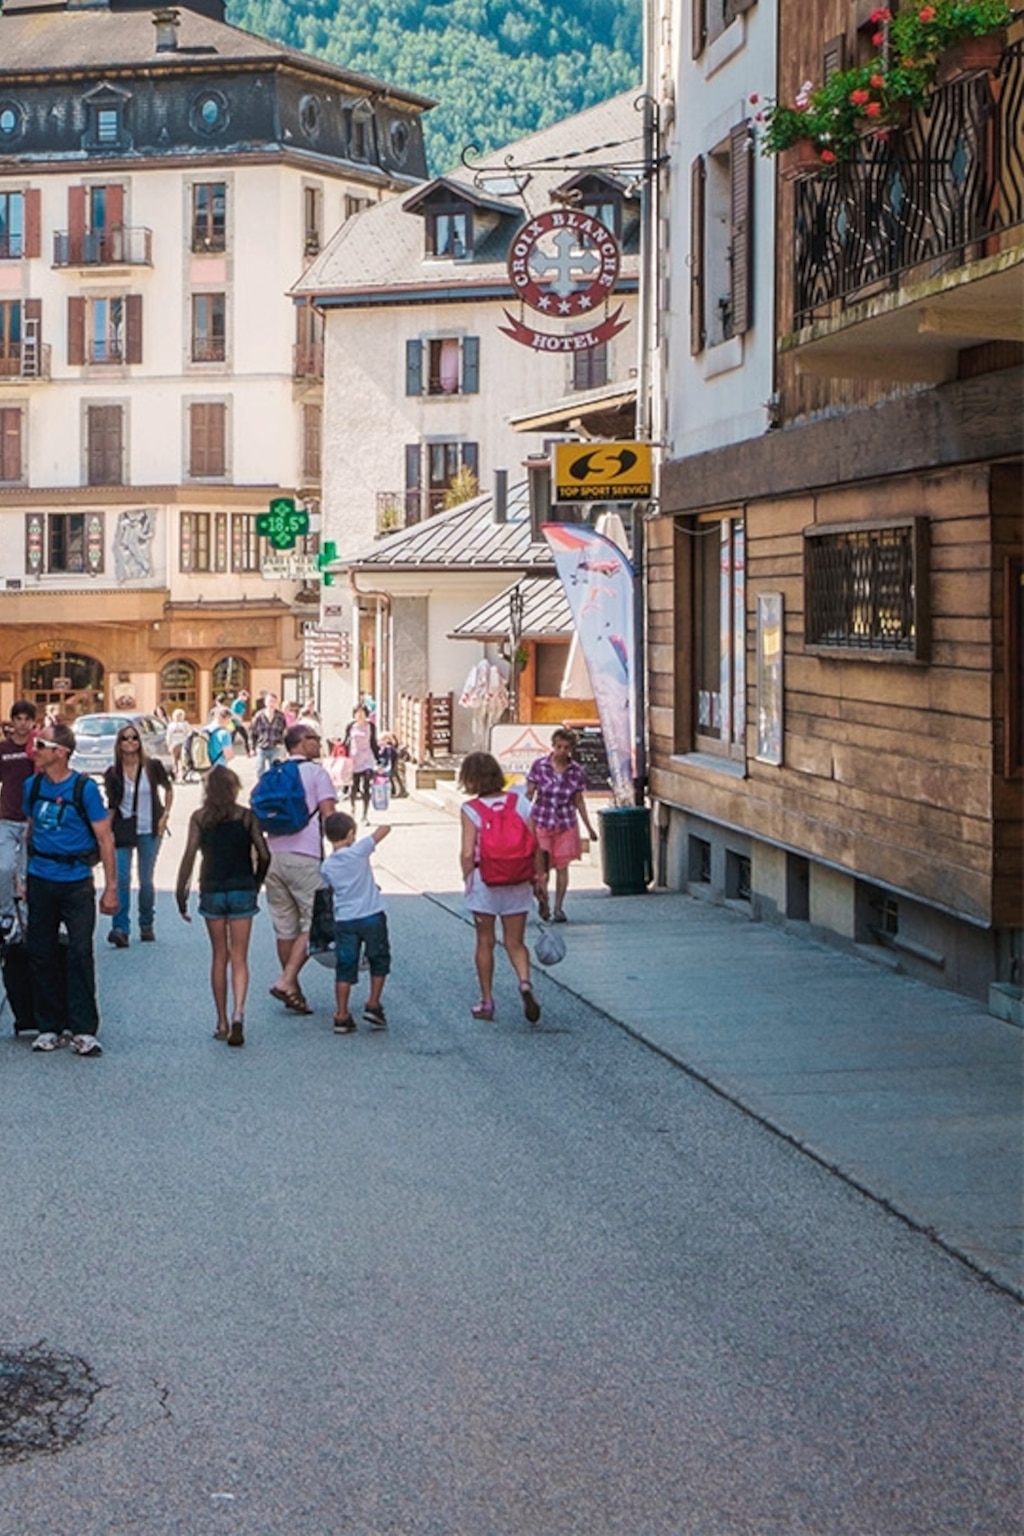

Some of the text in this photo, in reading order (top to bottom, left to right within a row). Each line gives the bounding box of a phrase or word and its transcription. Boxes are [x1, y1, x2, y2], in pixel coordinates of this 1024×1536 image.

[513, 213, 616, 287] CROIX BLANCHE
[531, 332, 599, 351] HOTEL
[559, 484, 649, 498] TOP SPORT SERVICE
